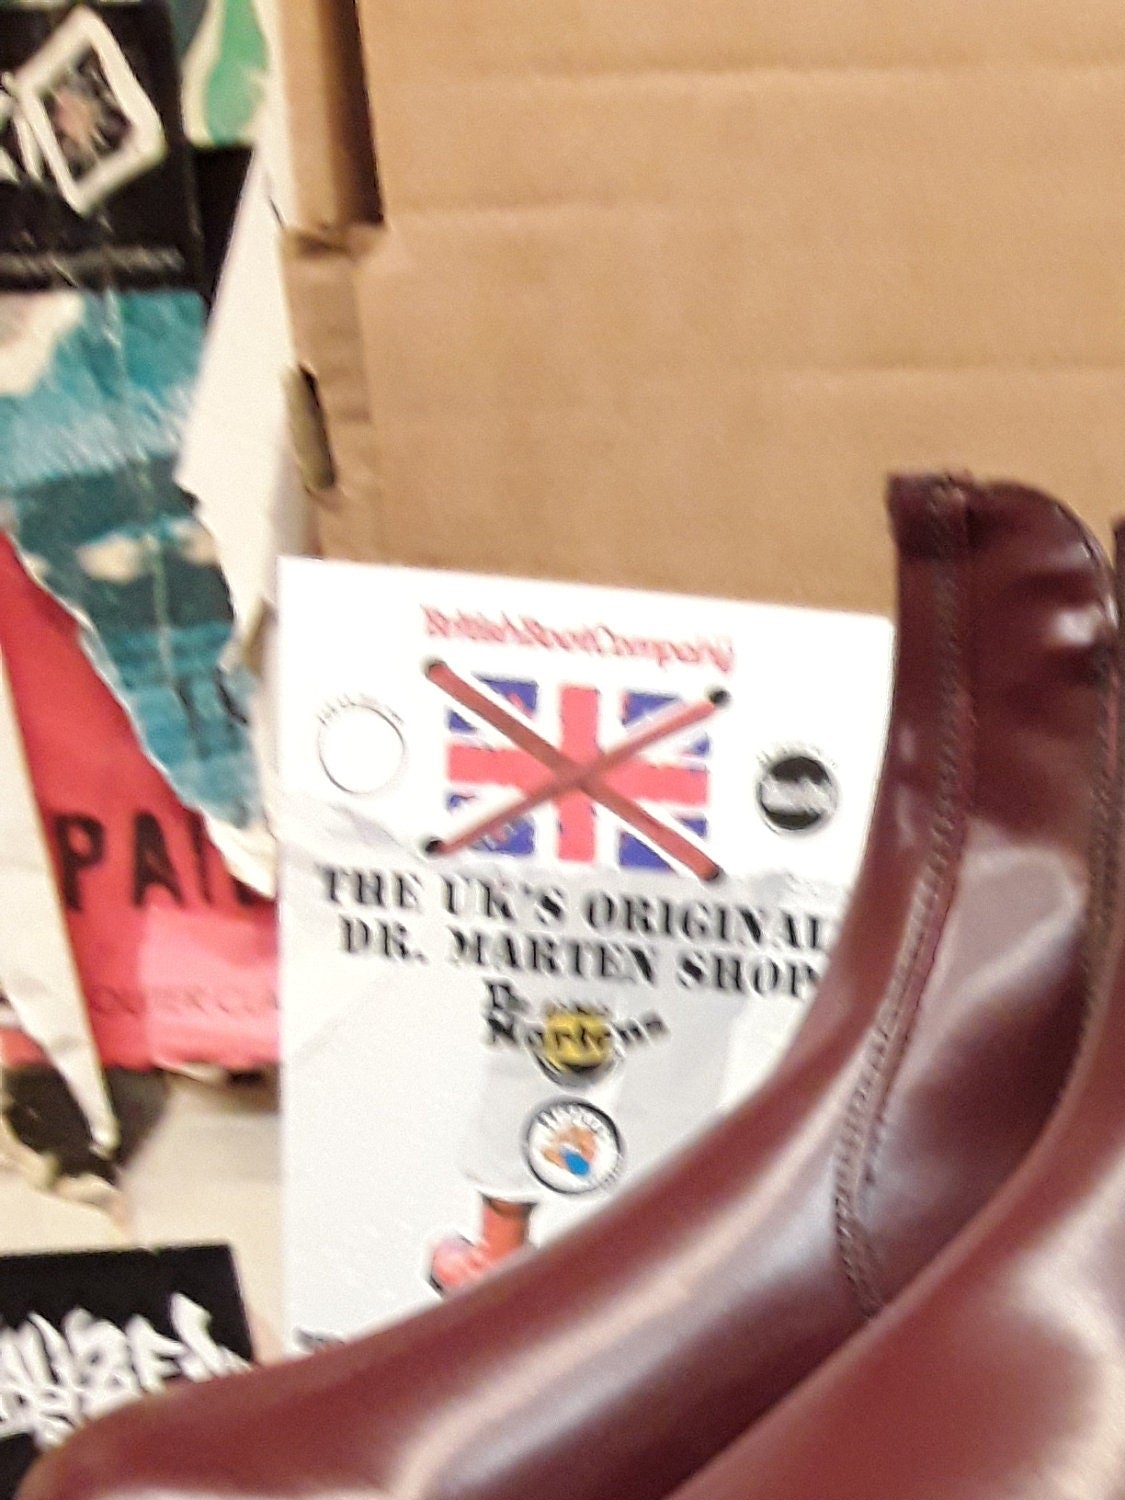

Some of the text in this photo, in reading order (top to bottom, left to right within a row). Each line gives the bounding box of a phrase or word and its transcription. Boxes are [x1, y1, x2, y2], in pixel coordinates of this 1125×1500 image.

[316, 866, 421, 910] THE
[438, 872, 566, 924] UK'S
[341, 914, 425, 962] DR.
[448, 924, 655, 986] MARTEN
